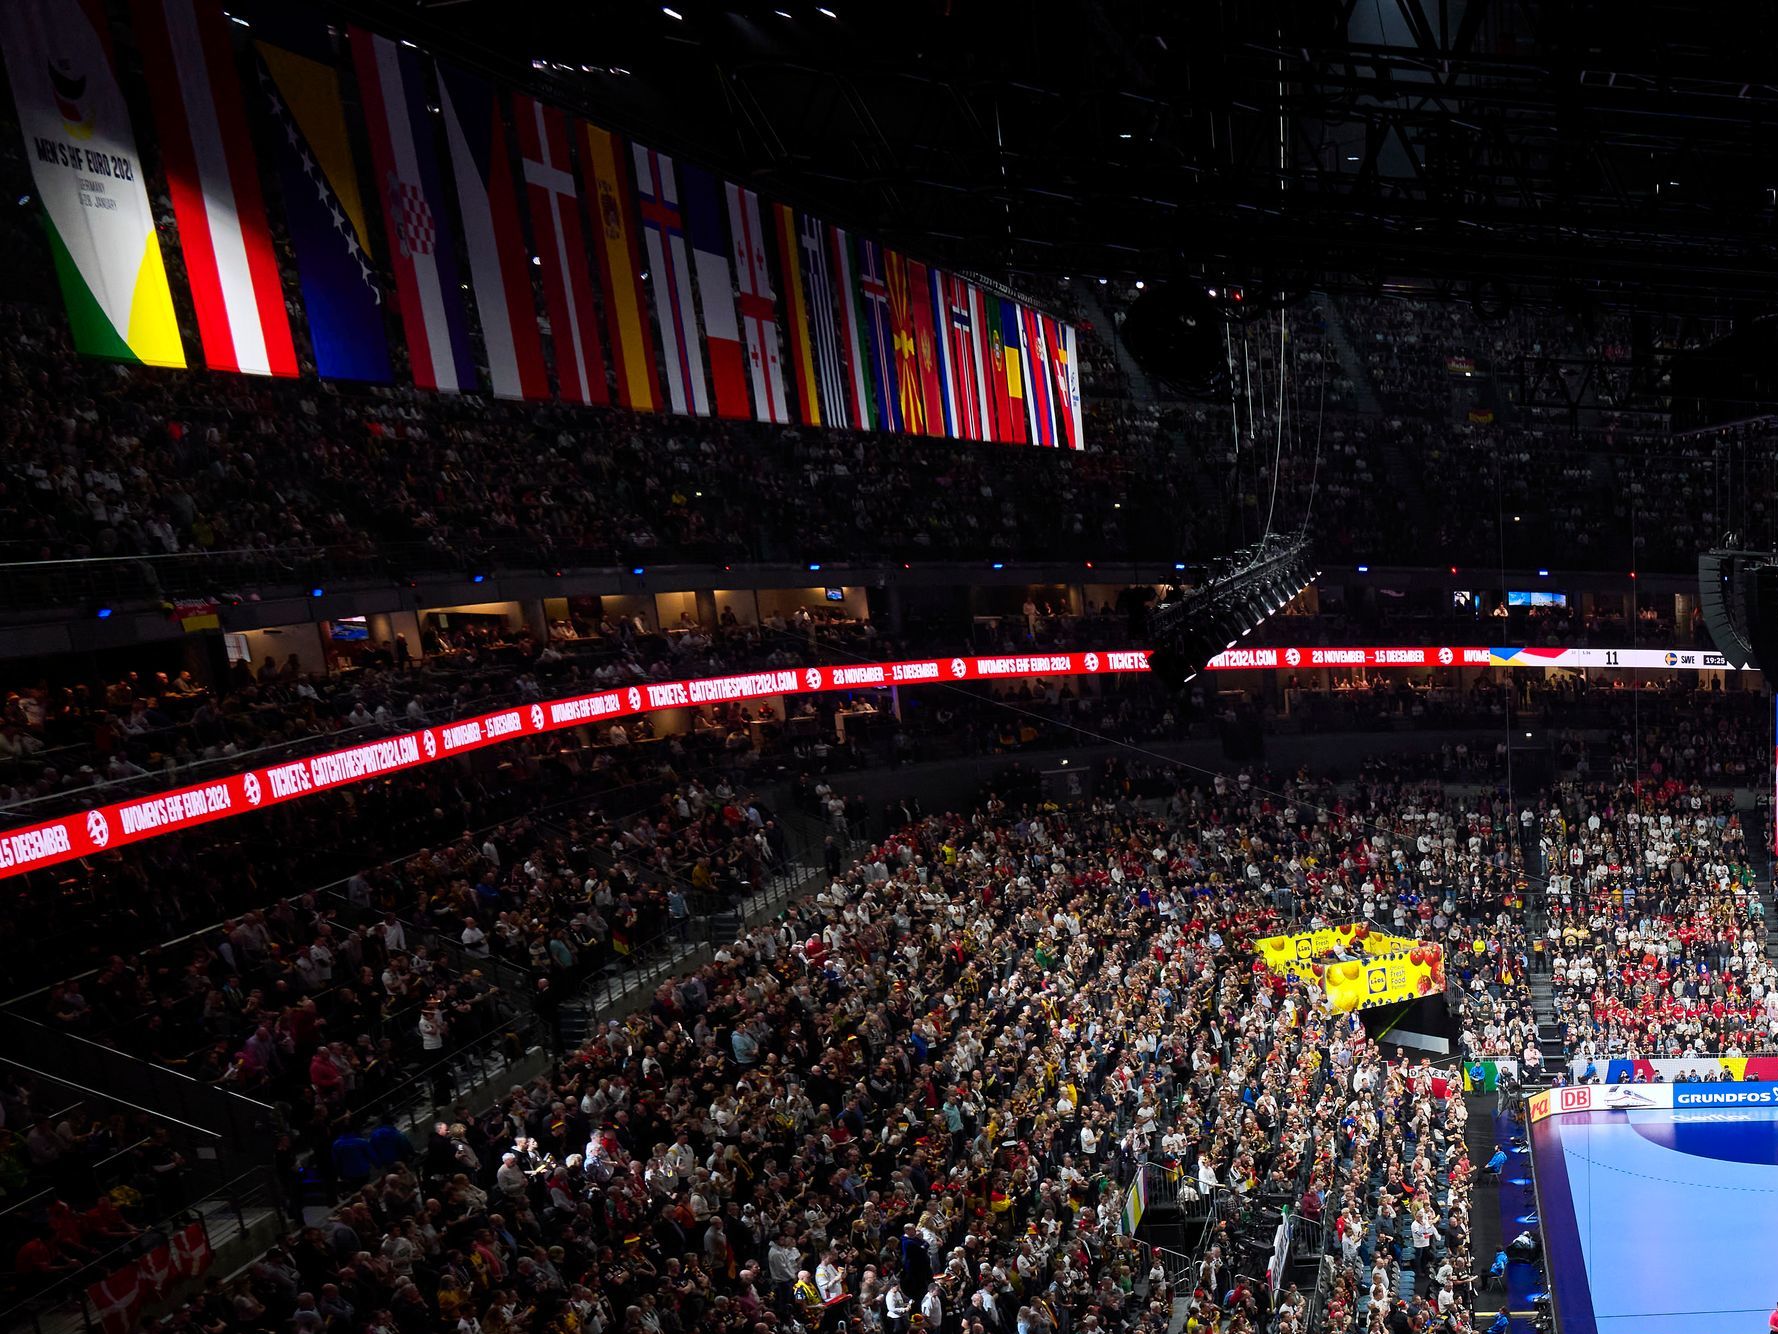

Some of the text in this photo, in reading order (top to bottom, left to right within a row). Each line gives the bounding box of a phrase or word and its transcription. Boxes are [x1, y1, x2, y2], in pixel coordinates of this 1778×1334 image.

[68, 144, 83, 170] HF
[977, 656, 1071, 675] WOMEN'S EHF EURO 2024
[1312, 651, 1424, 663] 28 NOVEMBER 15 DECEMBER
[1605, 652, 1618, 665] 11
[1681, 655, 1726, 665] SWE 19:25
[833, 662, 938, 685] 28 NOVEMBER 15 DECEMBER
[647, 671, 798, 707] TICKETS: CATCHTHESPIRIT2024.COM
[604, 693, 620, 713] 2024
[450, 721, 482, 748] NOVEMBER
[267, 735, 420, 798] TICKETS: CATCHTHESPIRIT2024.COM
[119, 783, 231, 835] WOMEN'S EHF EURO 2024
[12, 824, 71, 865] DECEMBER
[1563, 1089, 1588, 1108] DB
[1677, 1091, 1771, 1104] GRUNDFOS
